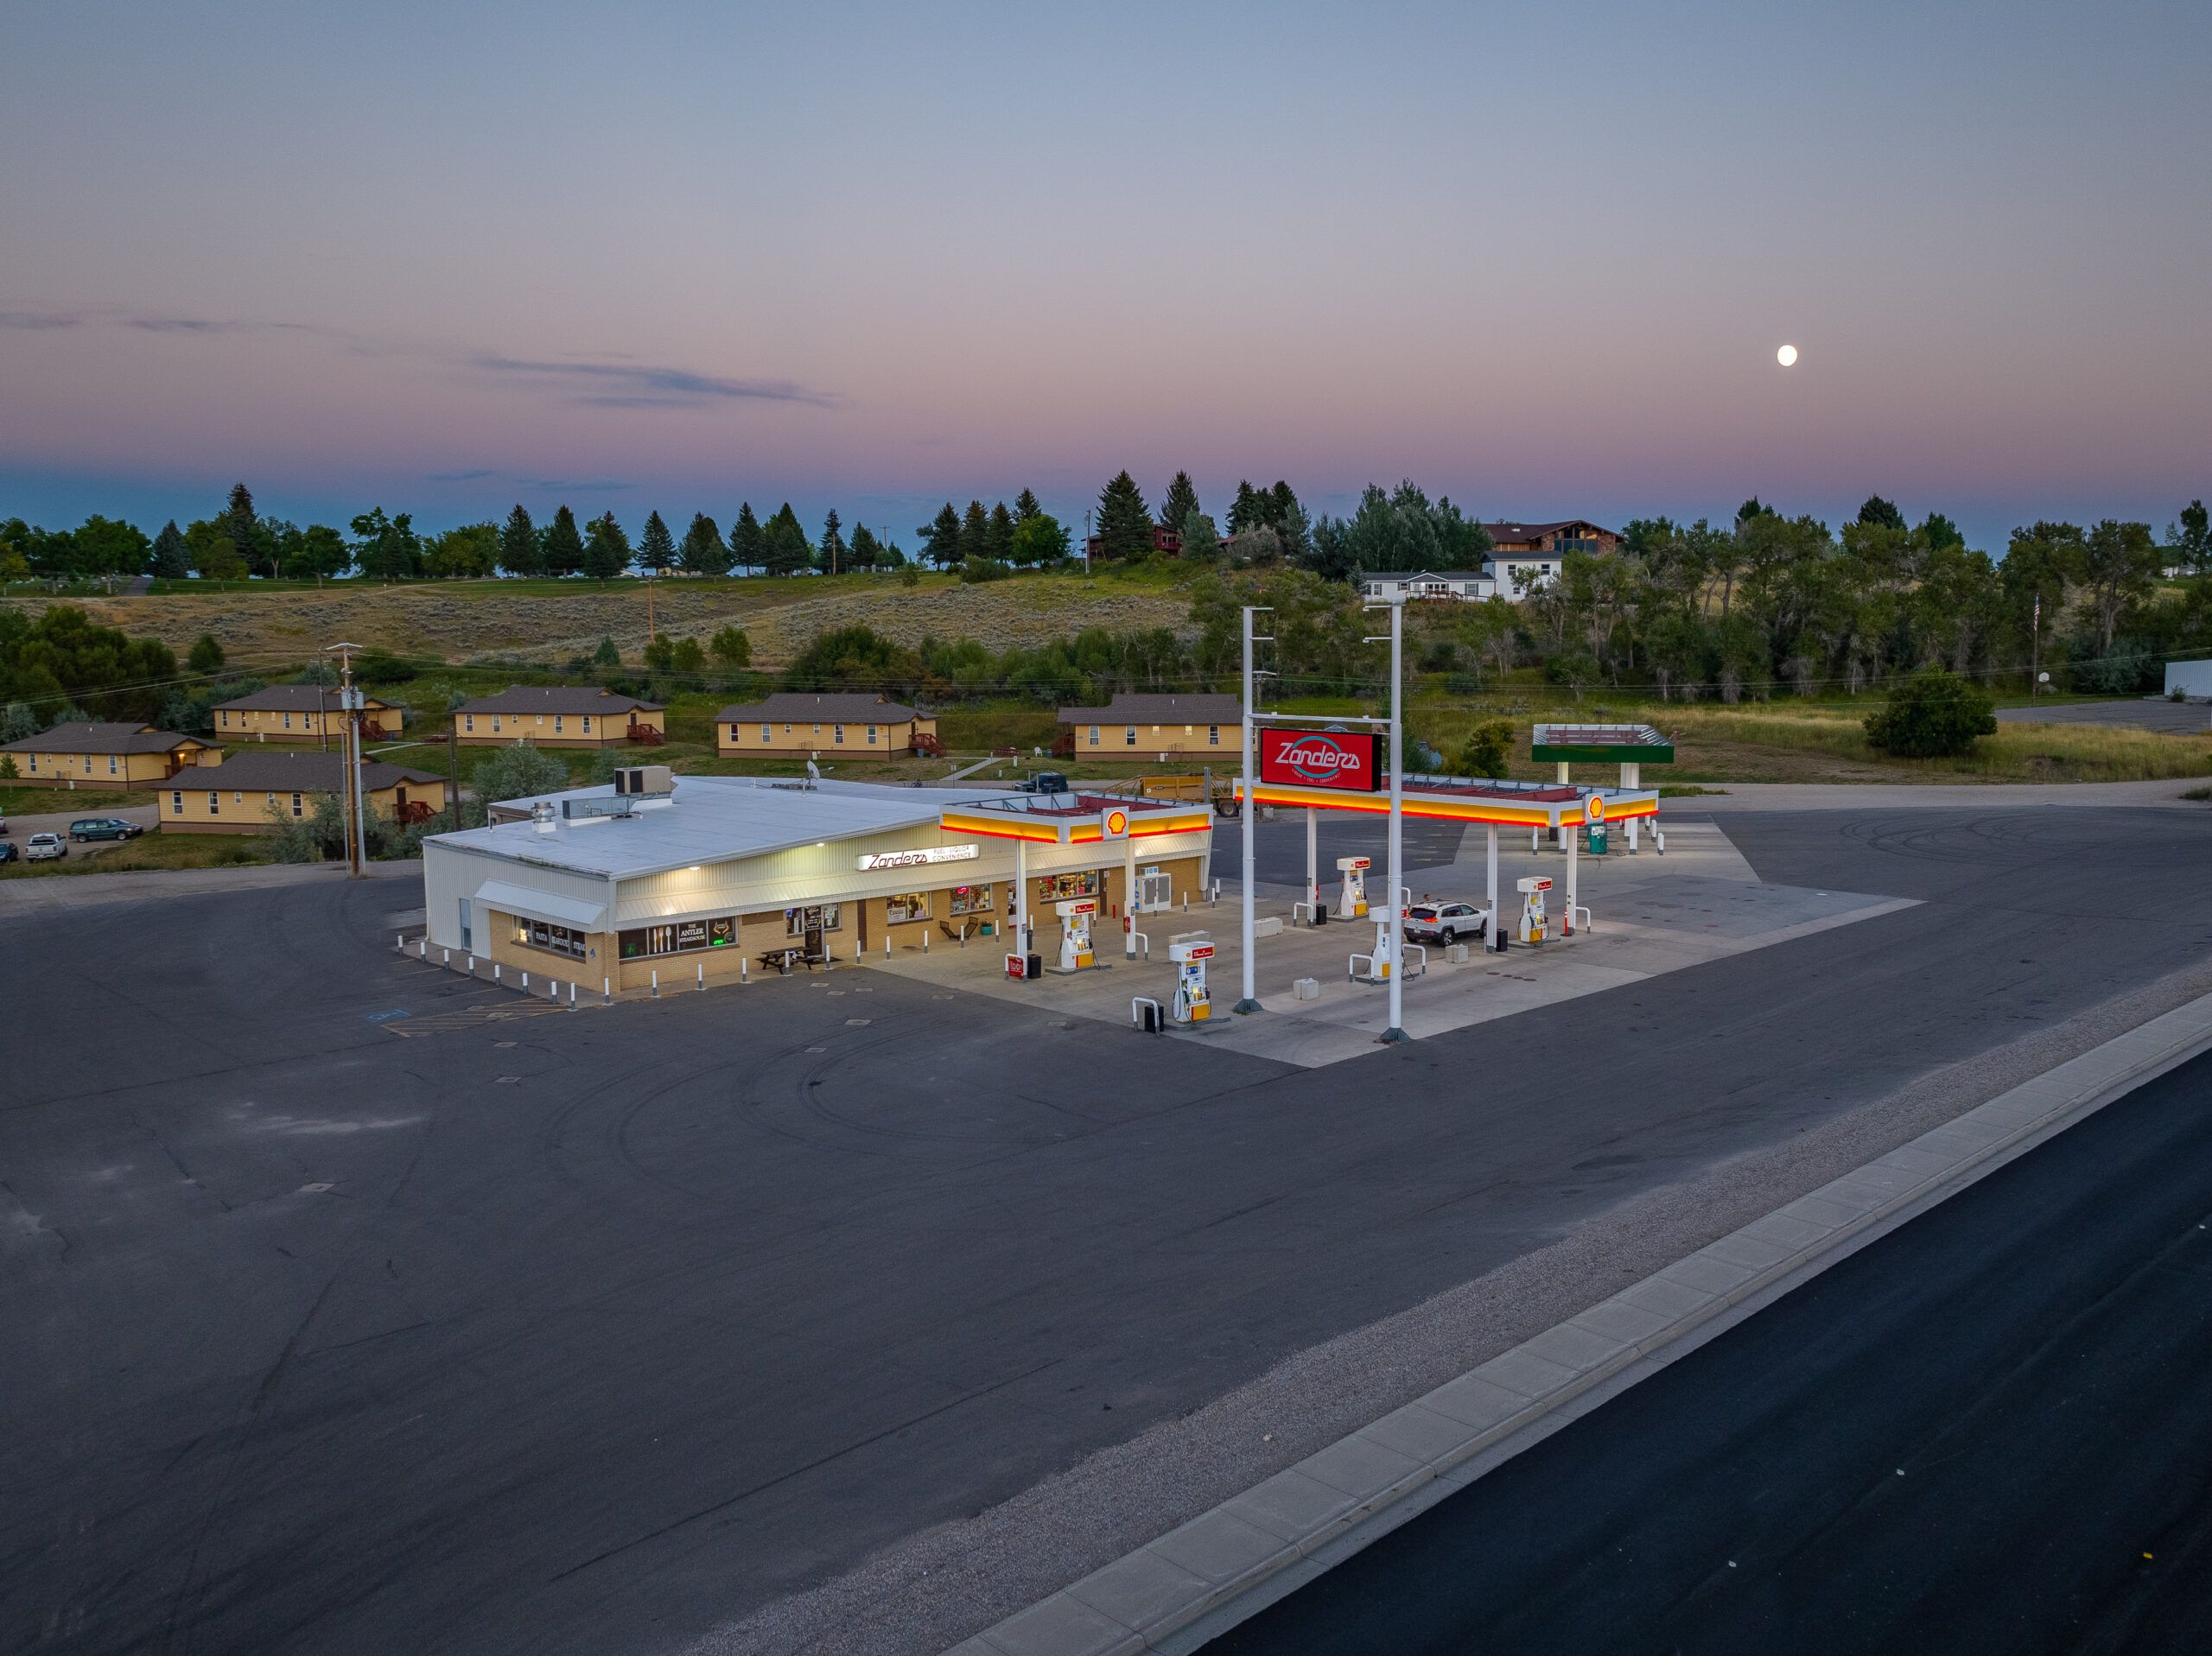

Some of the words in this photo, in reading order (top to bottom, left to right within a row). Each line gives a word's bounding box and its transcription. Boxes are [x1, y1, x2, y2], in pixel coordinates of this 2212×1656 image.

[1274, 742, 1360, 770] Zander's
[868, 851, 928, 870] Zander's
[932, 853, 970, 861] CONVENIENCE
[536, 931, 548, 942] PASTA
[680, 928, 704, 937] ANTLER
[551, 936, 570, 948] SEAFOOD
[679, 934, 706, 943] STEAKHOUSE
